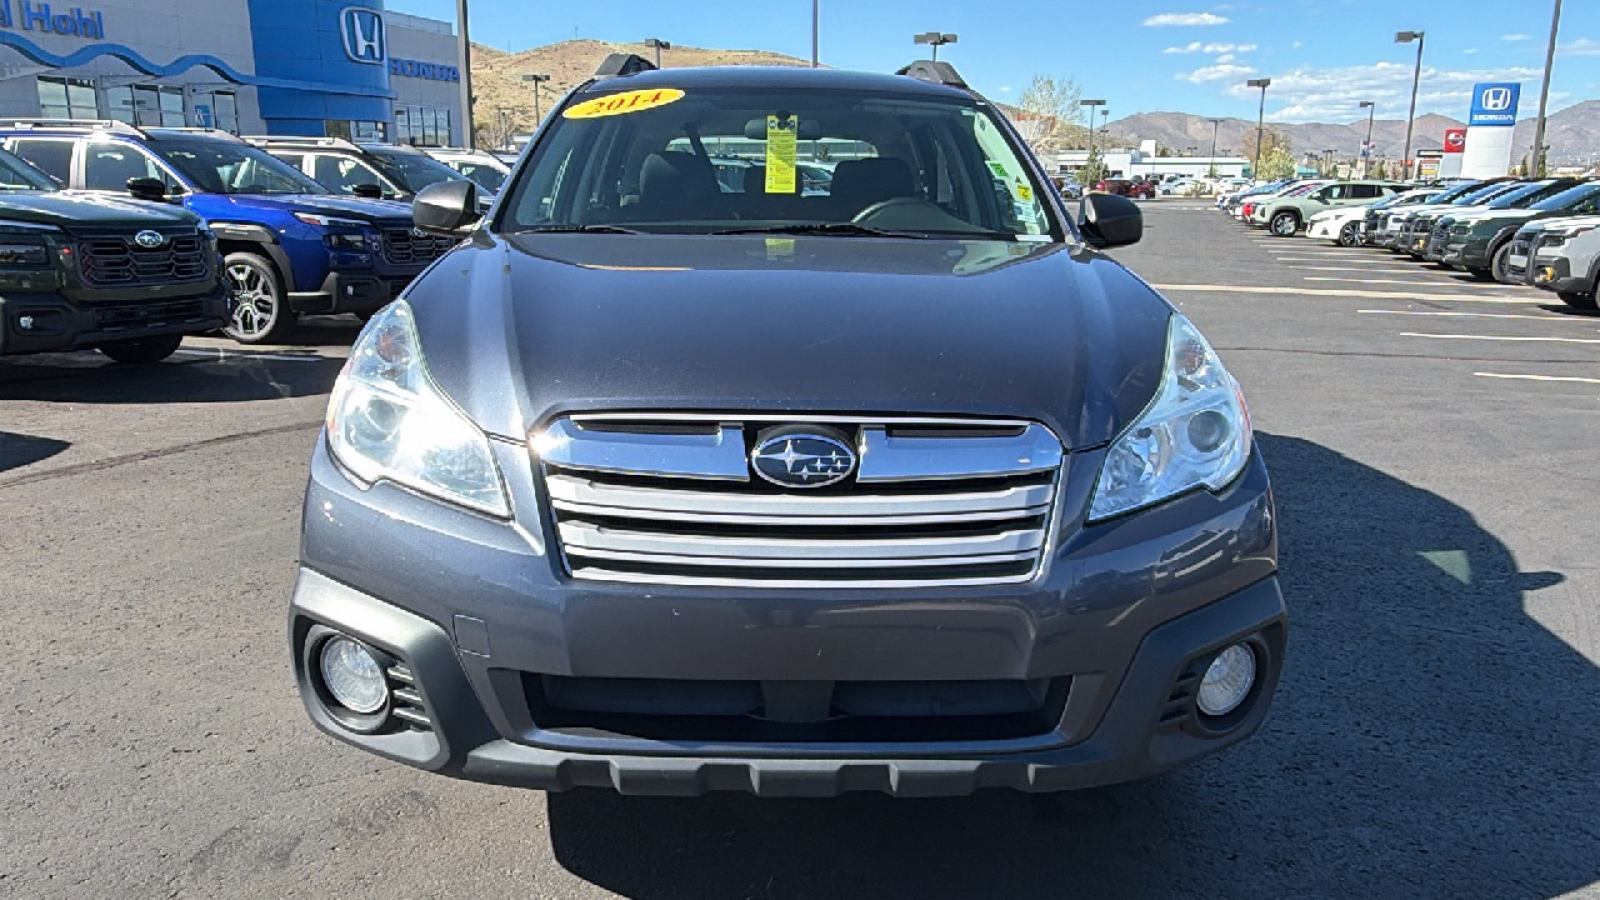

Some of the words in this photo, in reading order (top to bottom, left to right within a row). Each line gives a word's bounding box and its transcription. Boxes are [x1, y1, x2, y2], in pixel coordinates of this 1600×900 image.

[22, 0, 105, 39] Hohl
[388, 57, 460, 81] HONDA
[586, 91, 663, 115] 2014
